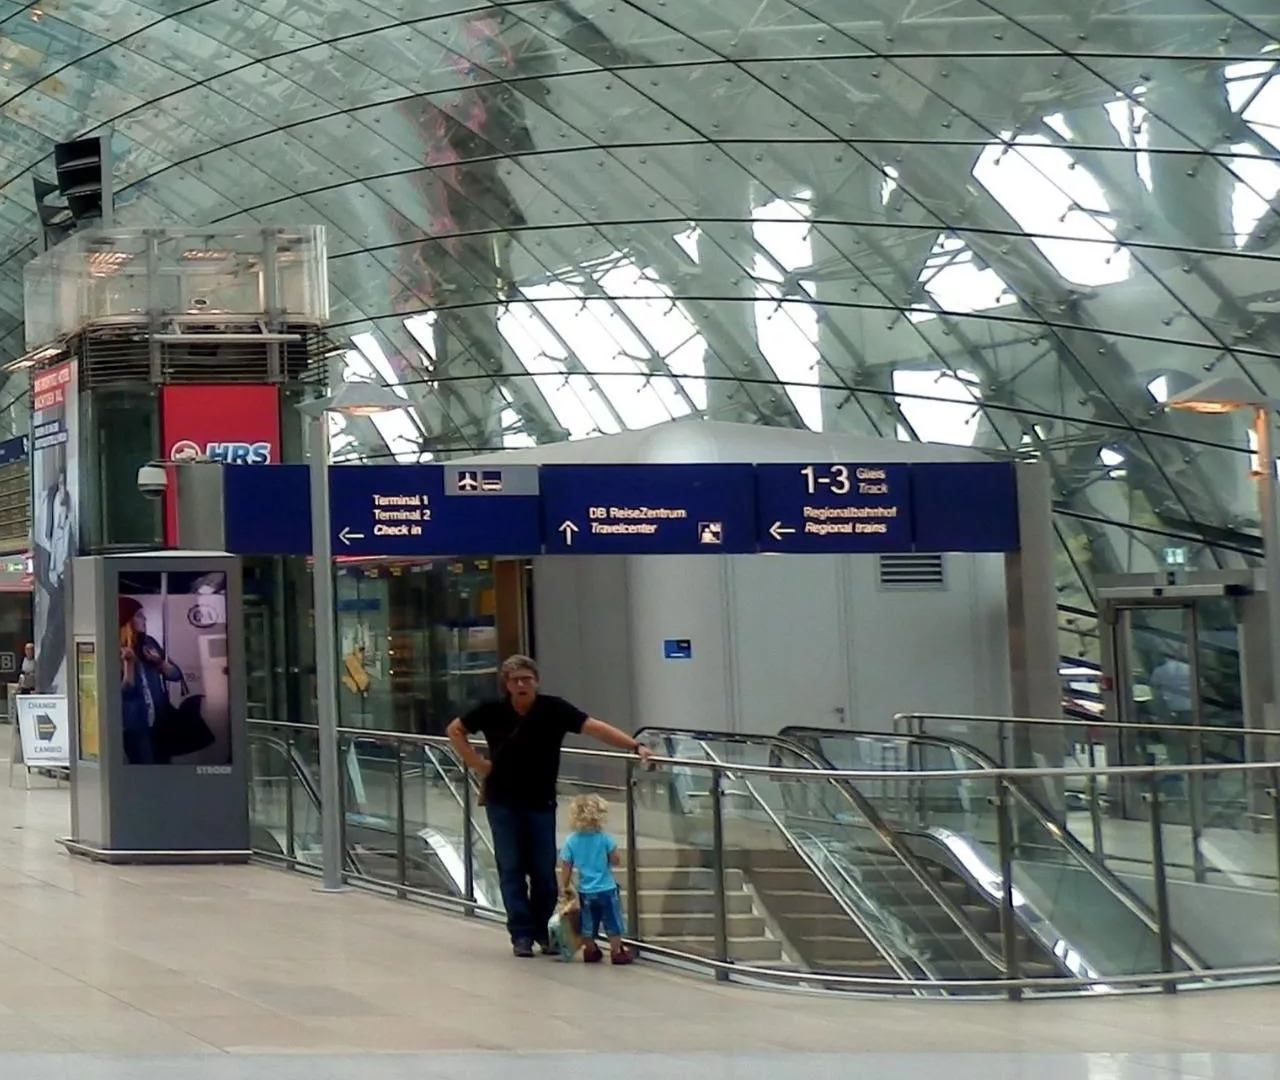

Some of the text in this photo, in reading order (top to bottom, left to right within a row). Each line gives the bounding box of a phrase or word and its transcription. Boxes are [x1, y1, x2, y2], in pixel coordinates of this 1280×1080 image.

[205, 442, 271, 465] HRS
[801, 465, 850, 494] 1-3
[856, 467, 886, 480] Gleis
[857, 482, 888, 494] Track
[372, 495, 429, 506] Terminal 1
[373, 509, 431, 521] Terminal 2
[589, 507, 687, 519] DB ReiseZentrum
[803, 506, 897, 520] Regionalbahnhof
[373, 524, 422, 536] Check in
[590, 522, 657, 535] Travelcenter
[804, 522, 887, 535] Regional trains
